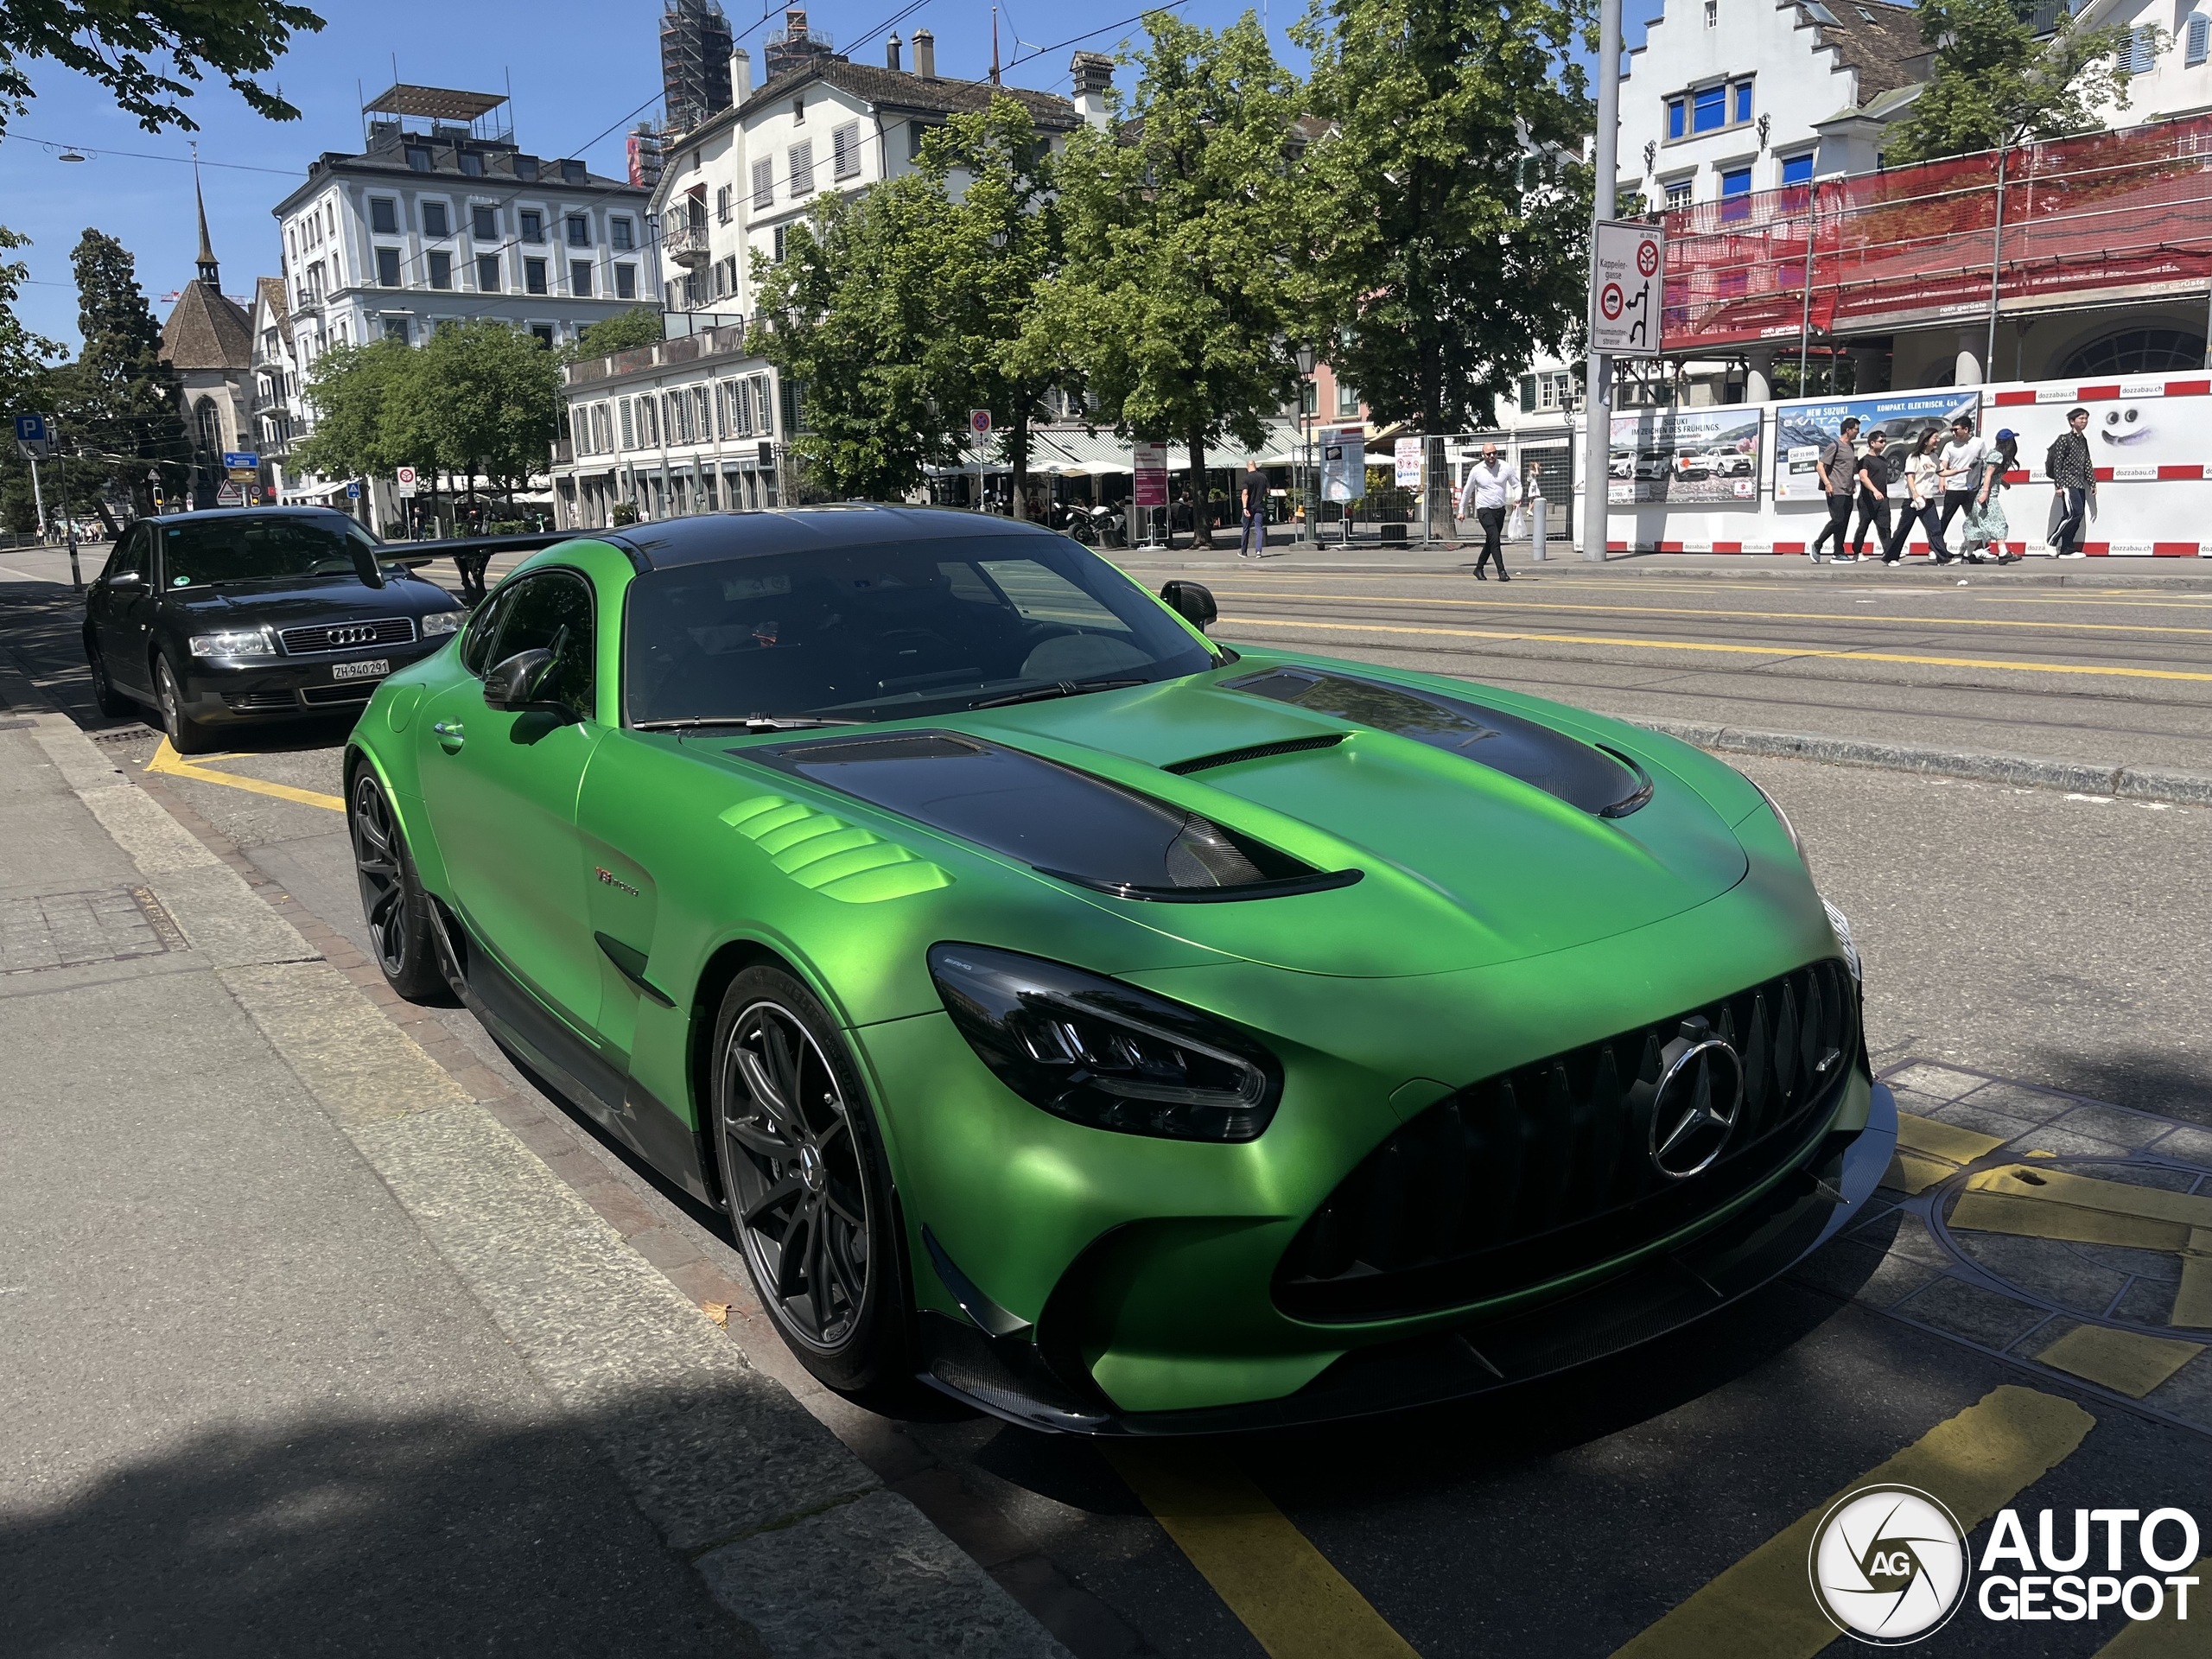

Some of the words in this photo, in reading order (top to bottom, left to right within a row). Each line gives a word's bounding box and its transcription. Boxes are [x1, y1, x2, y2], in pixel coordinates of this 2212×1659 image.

[1599, 258, 1628, 271] Kappeler-
[1605, 271, 1622, 281] gasse
[1957, 302, 1987, 311] gerüste
[1775, 324, 1801, 334] gerüste
[2121, 385, 2163, 394] dozzabau.ch
[2037, 390, 2077, 400] dozzabau.ch
[1877, 403, 1906, 412] KOMPAKT.
[1907, 399, 1945, 410] ELEKTRISCH.
[1806, 408, 1821, 417] NEW
[1822, 405, 1848, 416] SUZUKI
[1663, 417, 1688, 426] SUZUKI
[22, 419, 36, 437] P
[1641, 427, 1668, 435] ZEICHEN
[1683, 423, 1721, 432] FRÜHLINGS.
[2115, 468, 2157, 477] dozzabau.ch
[2111, 543, 2152, 552] dozzabau.ch
[857, 1120, 868, 1133] R
